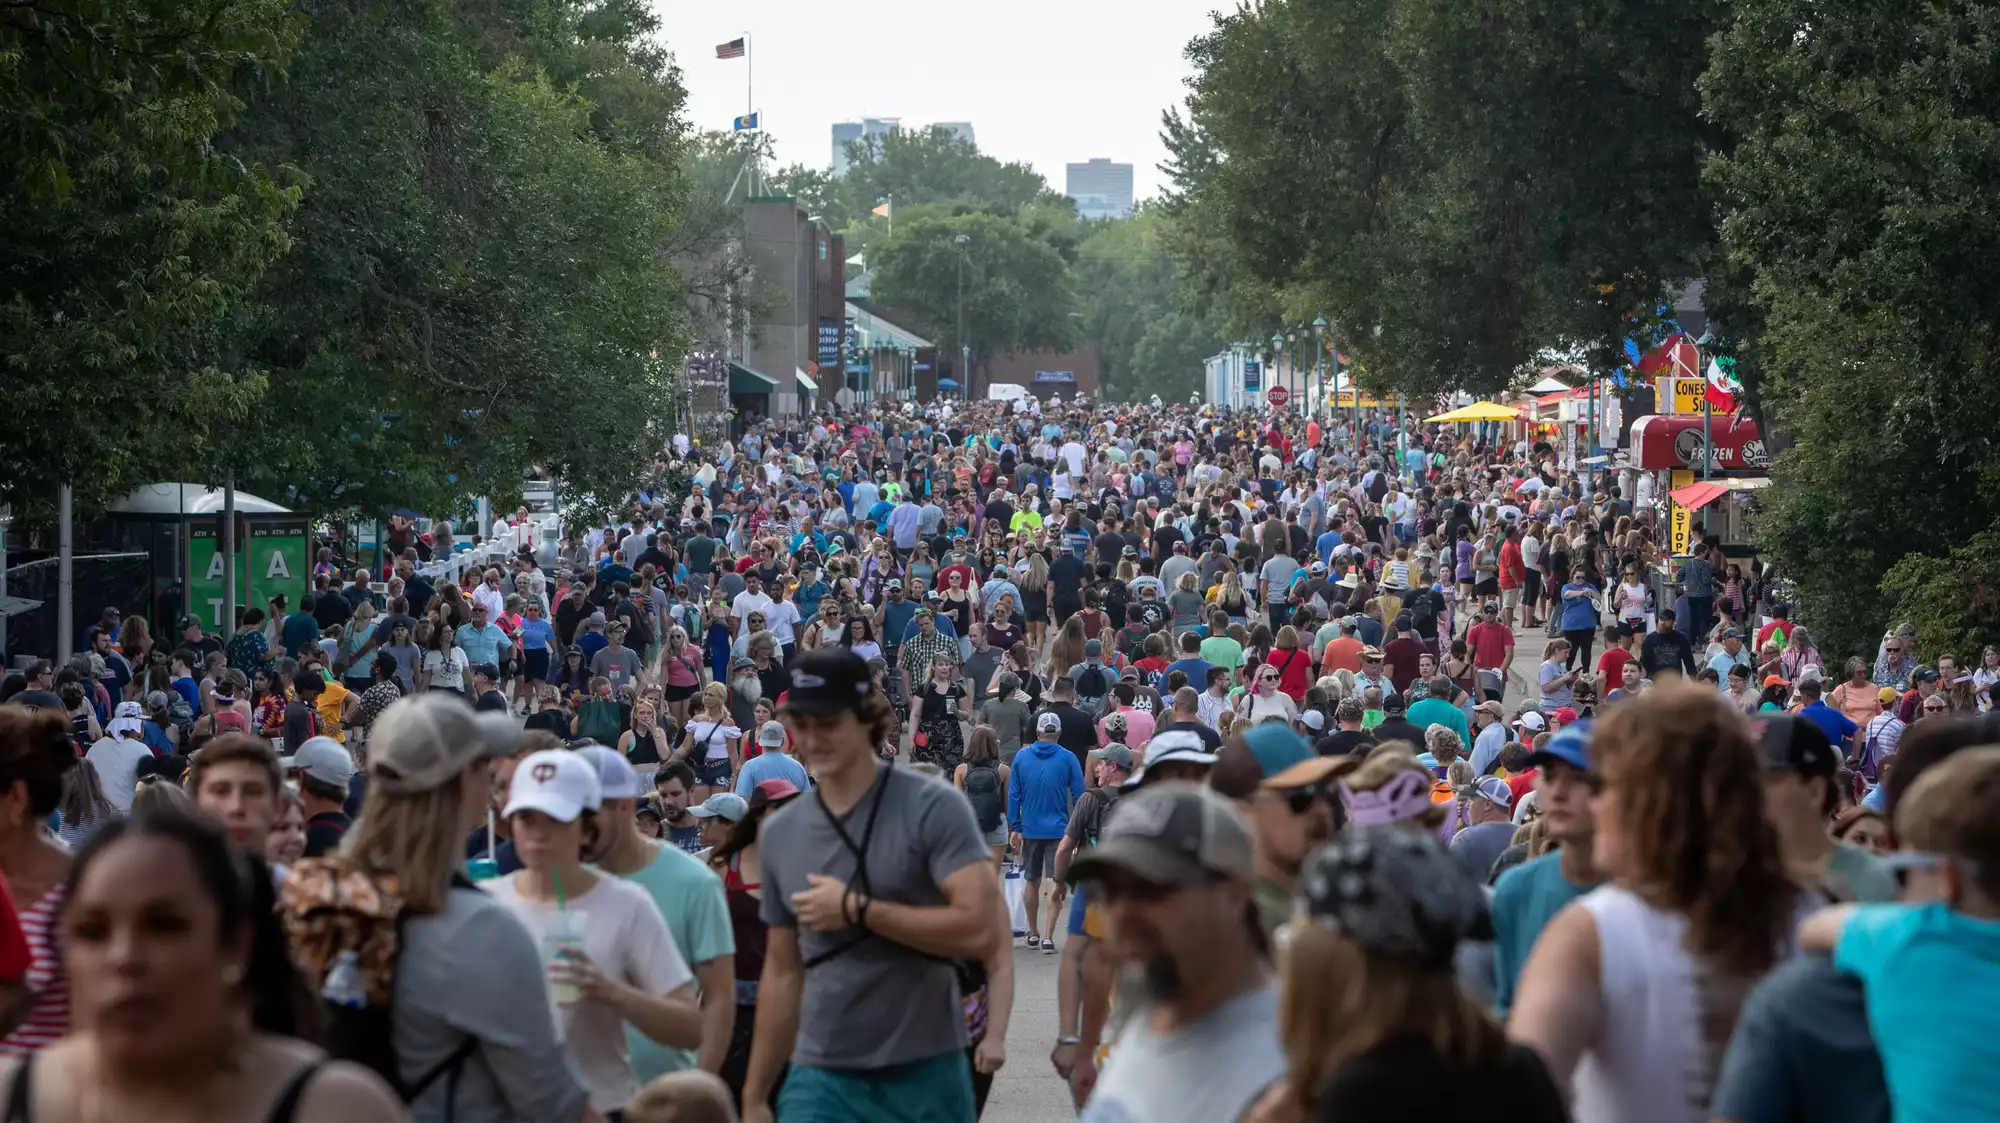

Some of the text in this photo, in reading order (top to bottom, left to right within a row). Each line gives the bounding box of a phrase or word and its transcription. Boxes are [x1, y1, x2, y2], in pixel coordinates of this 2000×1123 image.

[1675, 380, 1705, 396] CONES
[1269, 391, 1287, 401] STOP
[1690, 447, 1734, 461] FRZEN
[1675, 512, 1685, 551] STOP
